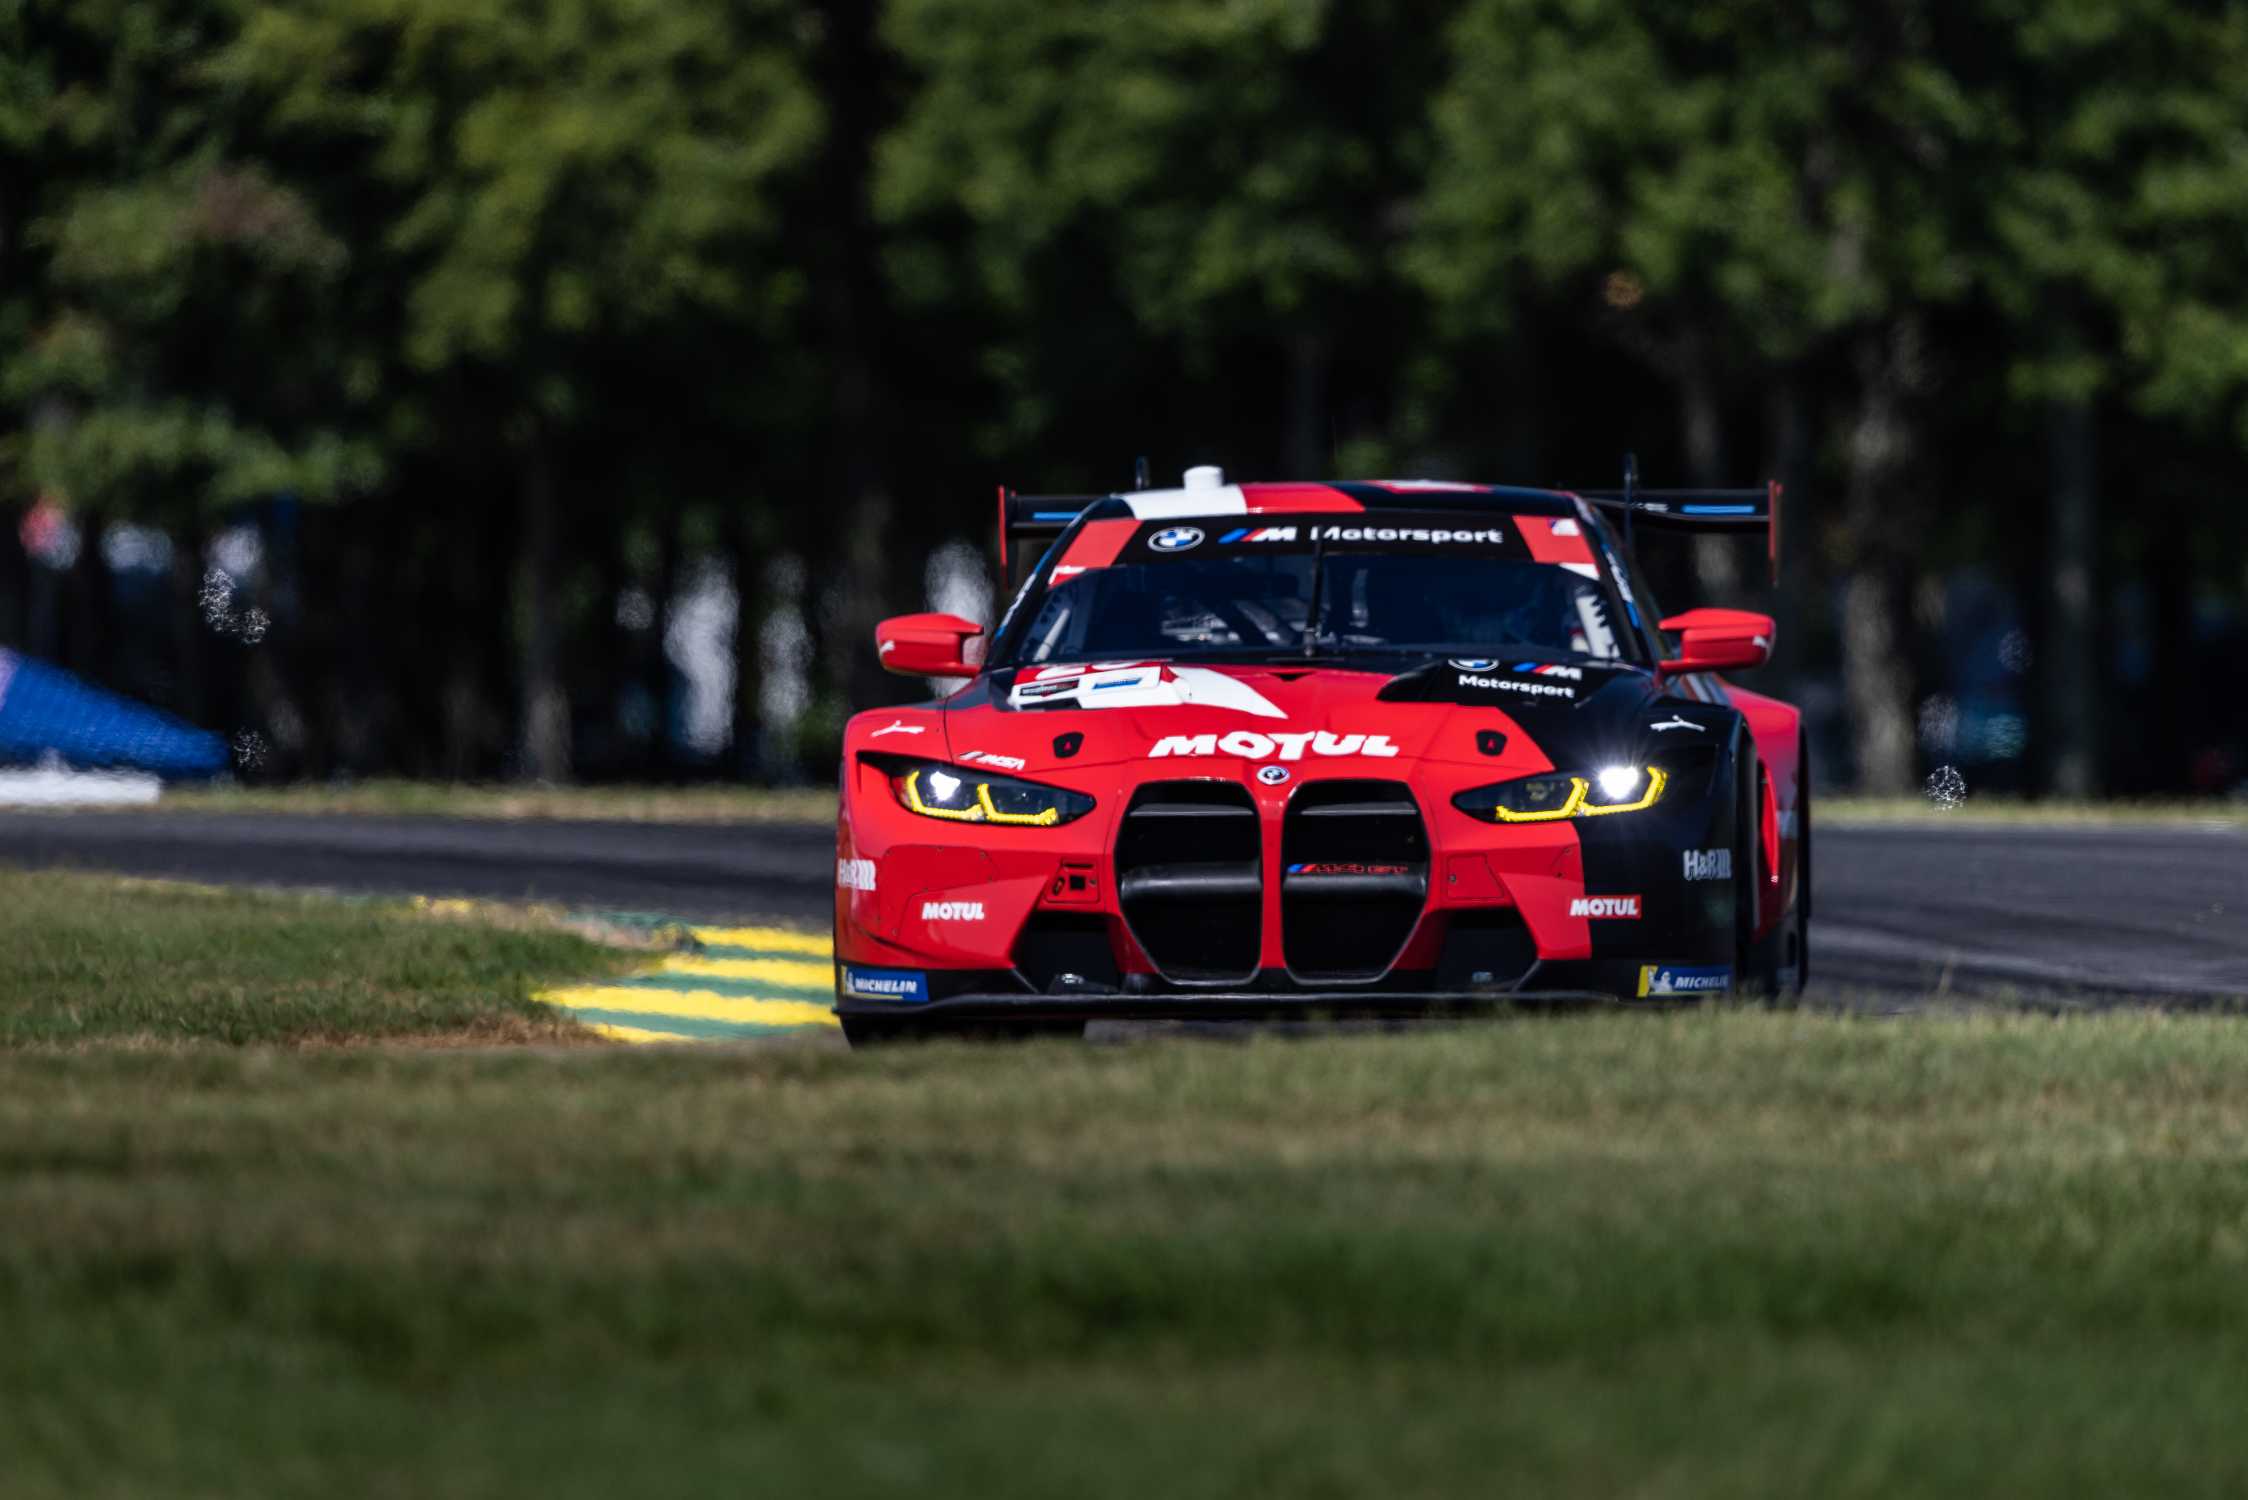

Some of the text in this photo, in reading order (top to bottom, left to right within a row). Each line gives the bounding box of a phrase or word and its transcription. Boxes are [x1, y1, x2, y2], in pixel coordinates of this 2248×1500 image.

[1310, 526, 1504, 543] Motorsport
[1458, 674, 1576, 698] Motorsport
[1147, 730, 1400, 760] MOTUL
[921, 902, 985, 920] MOTUL
[1569, 898, 1638, 916] MOTUL
[854, 977, 918, 993] MICHELIN
